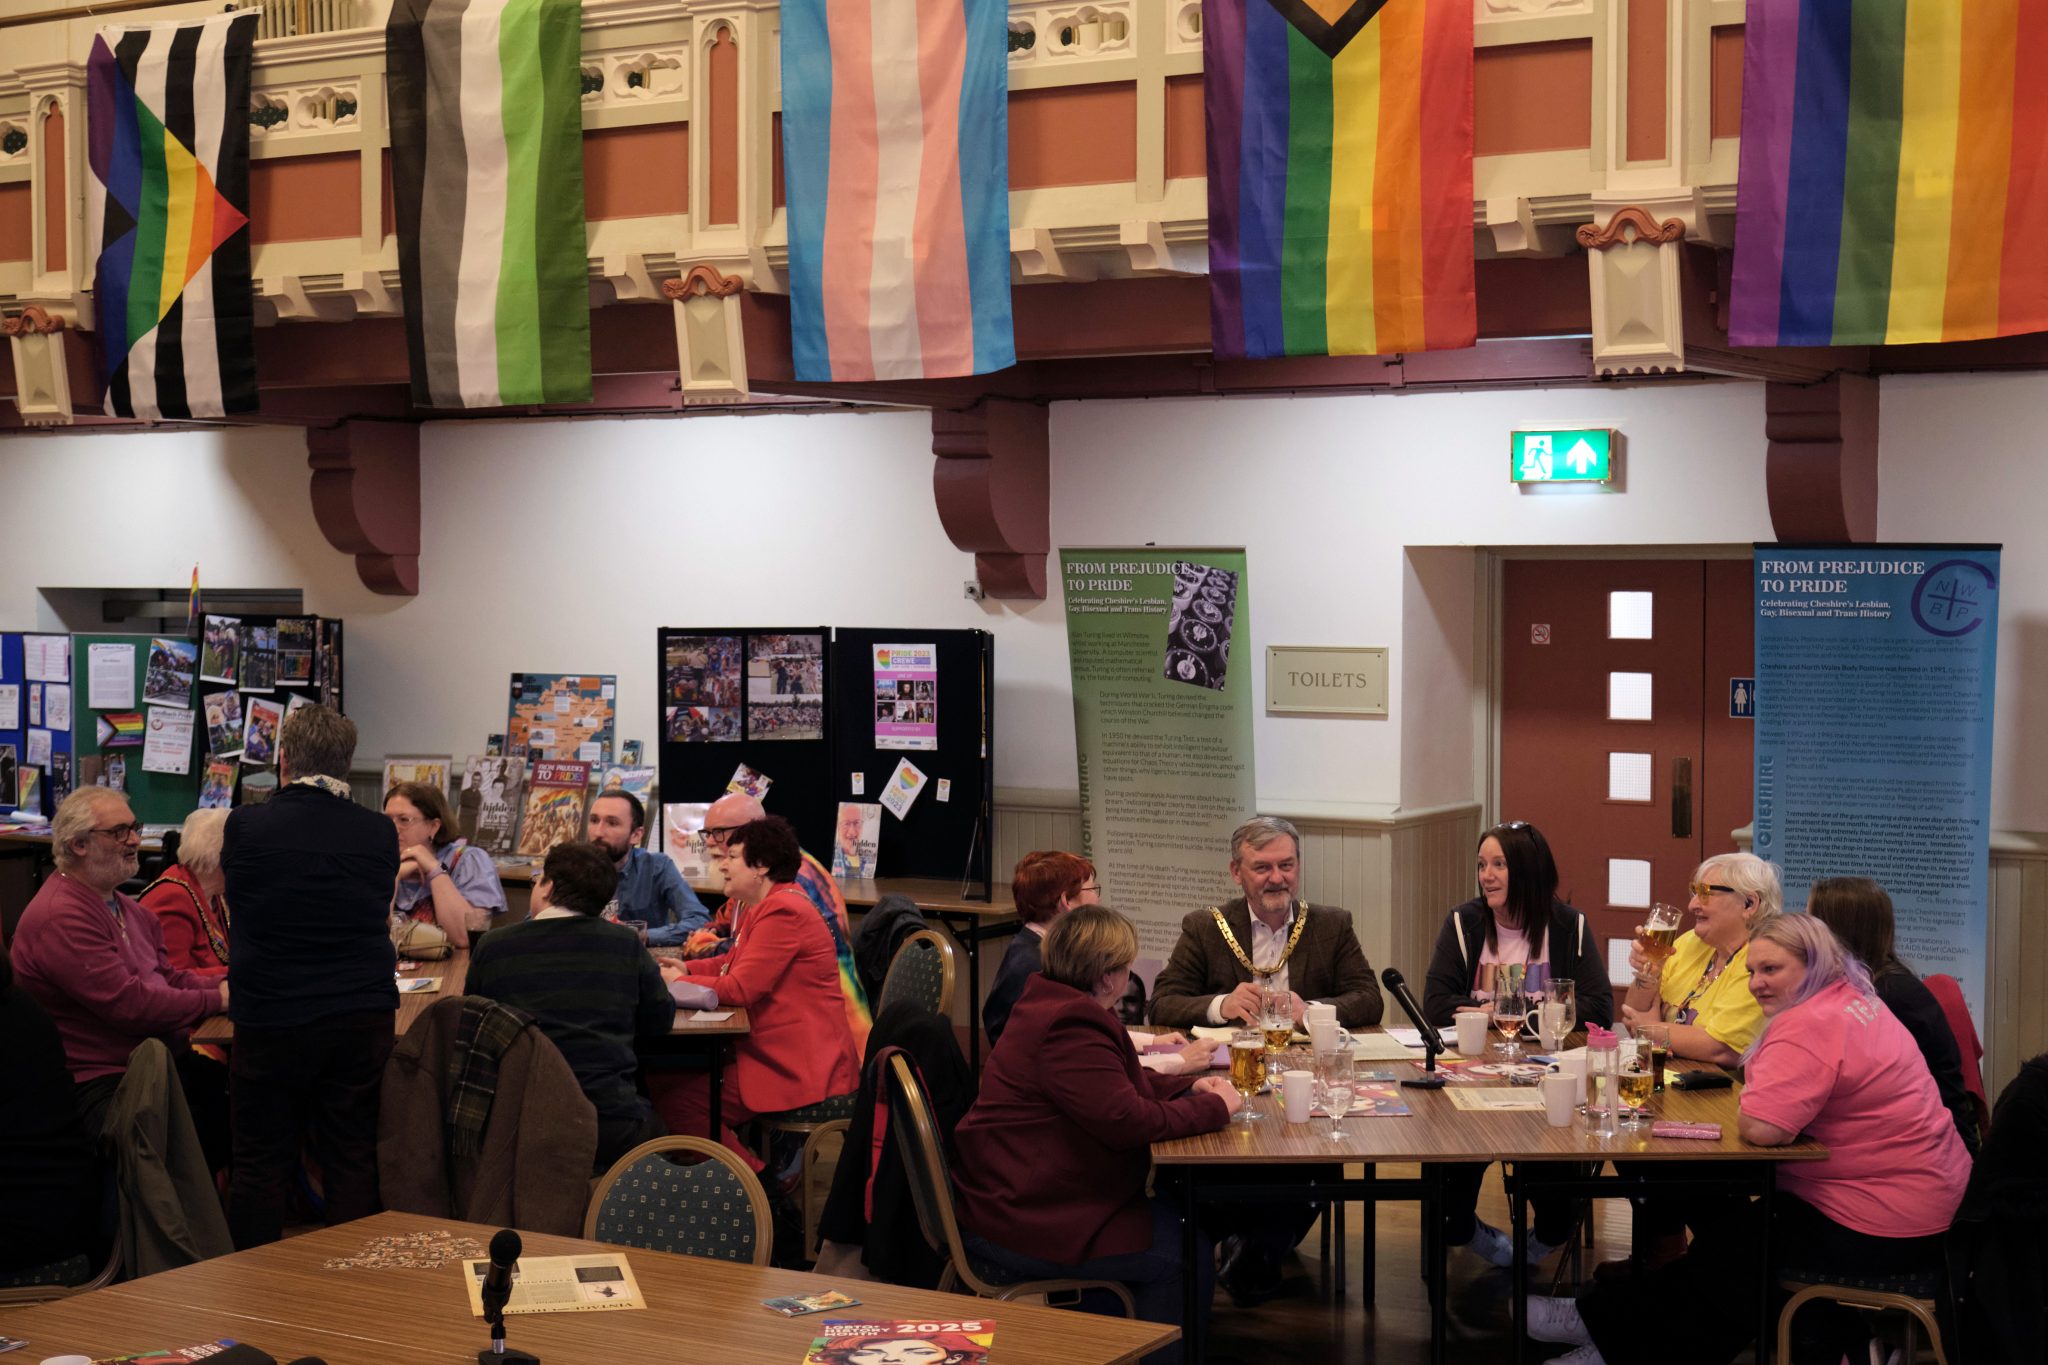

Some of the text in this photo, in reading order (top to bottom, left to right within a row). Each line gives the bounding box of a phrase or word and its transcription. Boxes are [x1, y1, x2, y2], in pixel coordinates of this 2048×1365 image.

[1066, 562, 1191, 575] FROM PREJUDICE
[1761, 560, 1926, 575] FROM PREJUDICE
[1066, 579, 1133, 591] TO PRIDE
[1761, 579, 1848, 593] TO PRIDE
[1068, 597, 1167, 606] Celebrating Cheshire's Lesbian,
[1760, 599, 1891, 609] Celebrating Cheshire's Lesbian,
[1143, 606, 1168, 614] History
[1760, 608, 1892, 619] Gay, Bisexual and Trans History
[1288, 671, 1367, 688] TOILETS
[537, 770, 552, 781] TO
[1759, 756, 1774, 847] CHESHIRE
[852, 840, 877, 849] hidden
[896, 1321, 983, 1334] 2025
